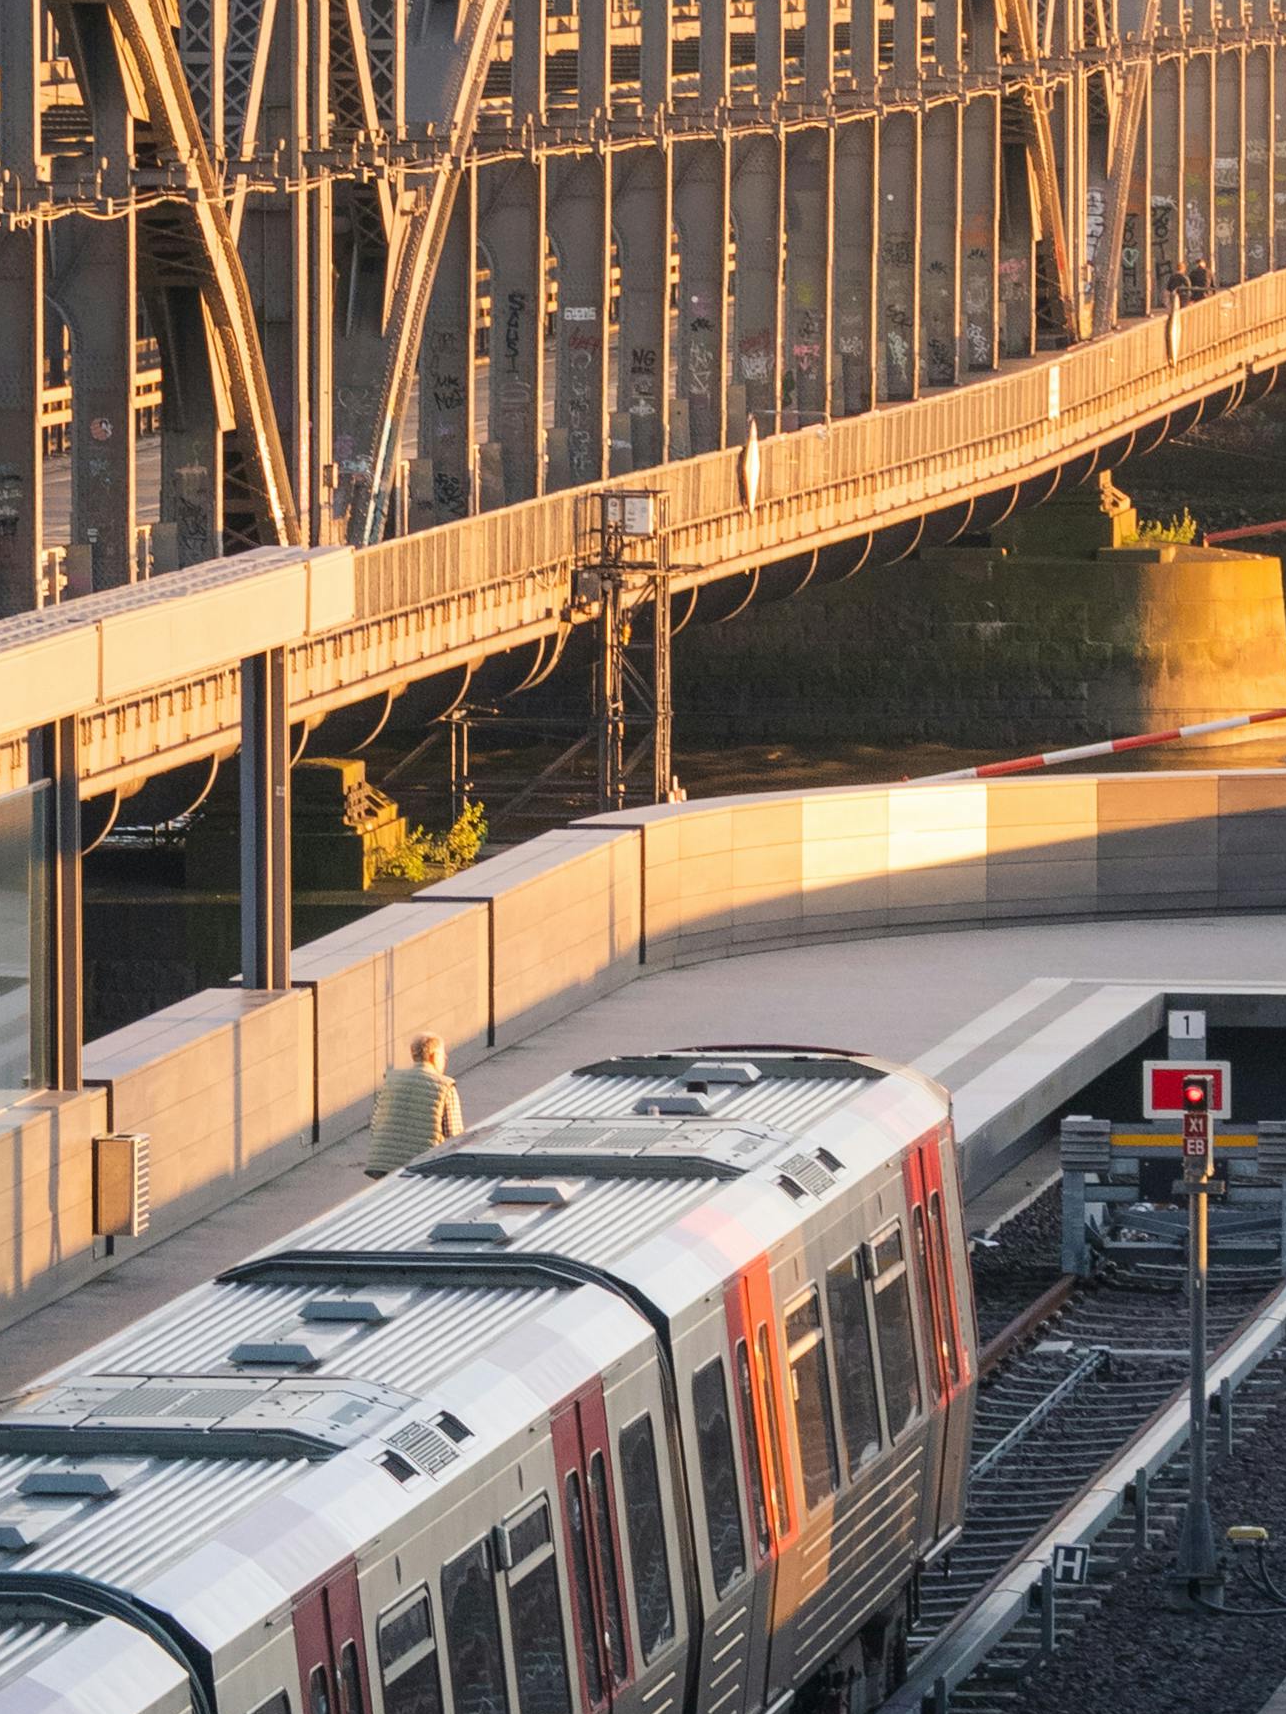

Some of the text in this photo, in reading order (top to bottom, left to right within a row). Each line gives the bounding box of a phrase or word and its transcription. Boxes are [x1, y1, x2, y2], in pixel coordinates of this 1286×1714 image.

[1183, 1015, 1190, 1035] 1
[1189, 1117, 1204, 1132] X1
[1187, 1140, 1205, 1155] EB
[1055, 1548, 1083, 1581] H
